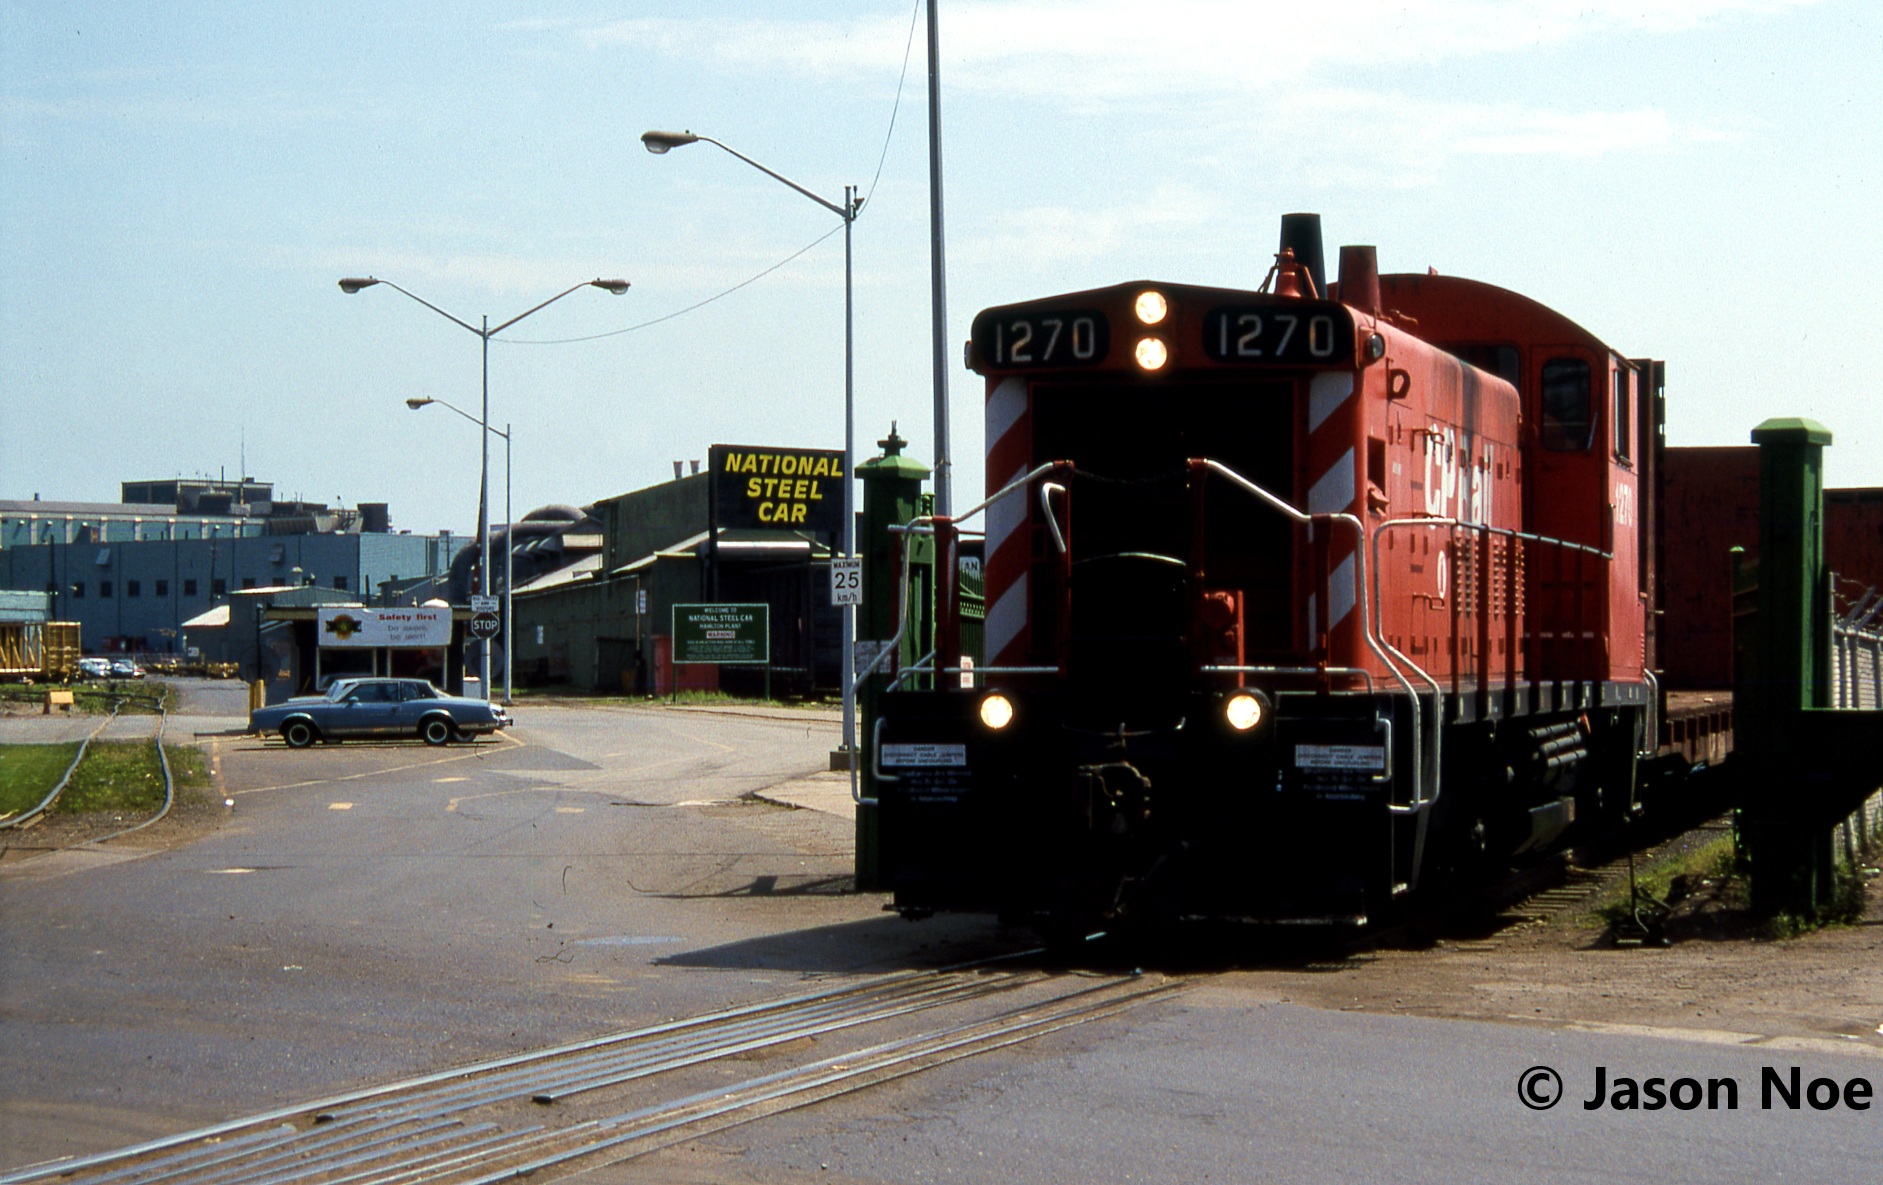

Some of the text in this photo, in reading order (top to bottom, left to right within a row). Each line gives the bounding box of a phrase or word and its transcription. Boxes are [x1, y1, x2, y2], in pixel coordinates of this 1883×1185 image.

[996, 317, 1095, 363] 1270
[1220, 314, 1335, 357] 1270
[725, 453, 843, 477] NATIONAL
[1425, 423, 1456, 530] CP
[747, 477, 823, 499] STEEL
[758, 501, 807, 523] CAR
[835, 571, 859, 589] 25
[837, 592, 857, 602] km/h
[378, 613, 437, 621] Safety first
[473, 620, 498, 630] STOP
[688, 614, 753, 622] NATIONAL STEEL CAR
